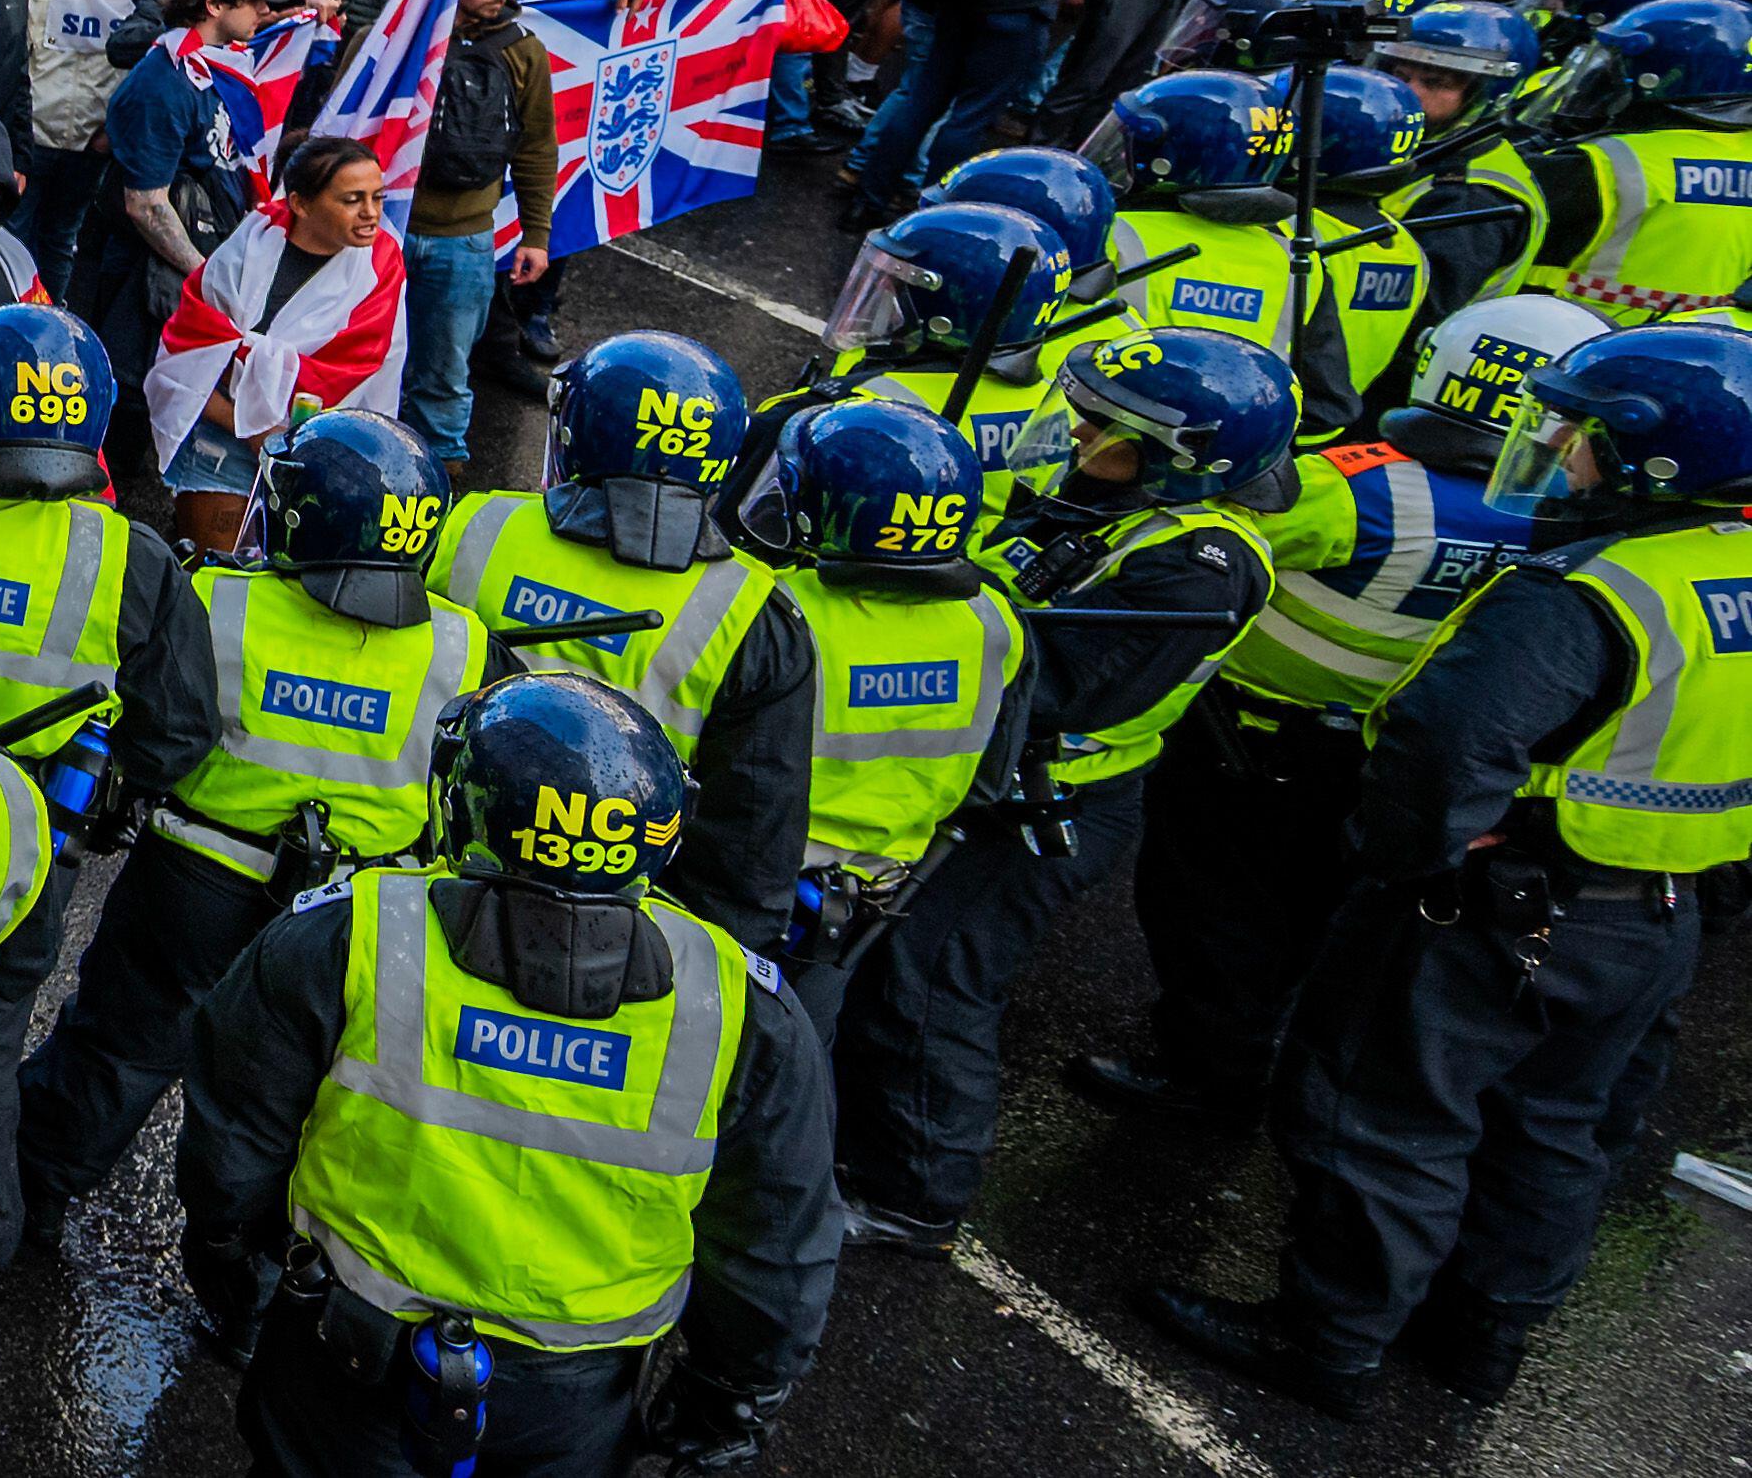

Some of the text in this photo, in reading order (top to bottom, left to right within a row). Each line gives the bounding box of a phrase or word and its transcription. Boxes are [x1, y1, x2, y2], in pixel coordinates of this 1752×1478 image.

[1179, 283, 1257, 316] POLICE
[16, 361, 83, 396] NC
[10, 394, 88, 426] 699
[637, 387, 715, 432] NC
[635, 421, 712, 459] 762
[380, 493, 442, 531] NC
[890, 491, 967, 527] NC
[380, 526, 428, 556] 90
[874, 525, 961, 552] 276
[272, 679, 378, 726] POLICE
[858, 669, 950, 700] POLICE
[534, 784, 638, 843] NC
[510, 826, 638, 876] 1399
[470, 1018, 613, 1079] POLICE
